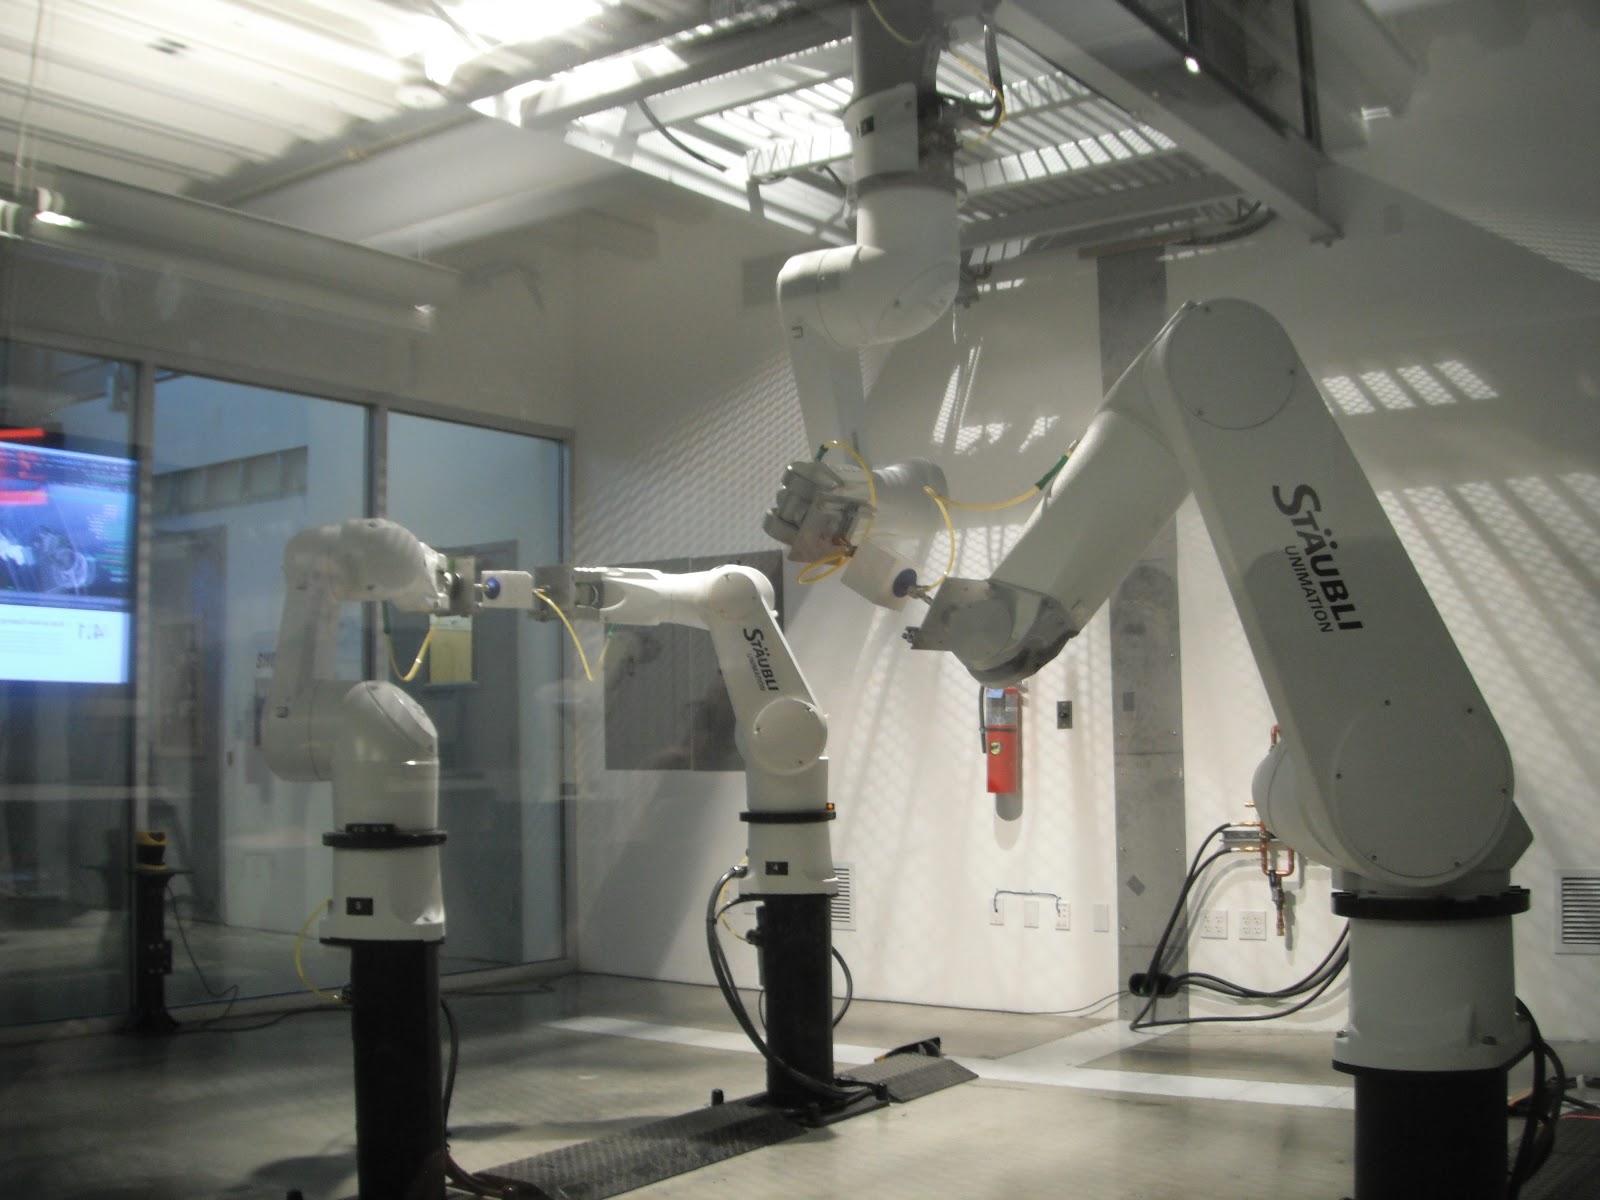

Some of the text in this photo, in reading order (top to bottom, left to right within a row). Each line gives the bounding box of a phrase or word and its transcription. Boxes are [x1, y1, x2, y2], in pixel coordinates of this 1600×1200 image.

[1272, 484, 1364, 630] STÄUBLI
[1285, 545, 1334, 633] UNIMATION
[743, 628, 779, 691] STÄUBLI
